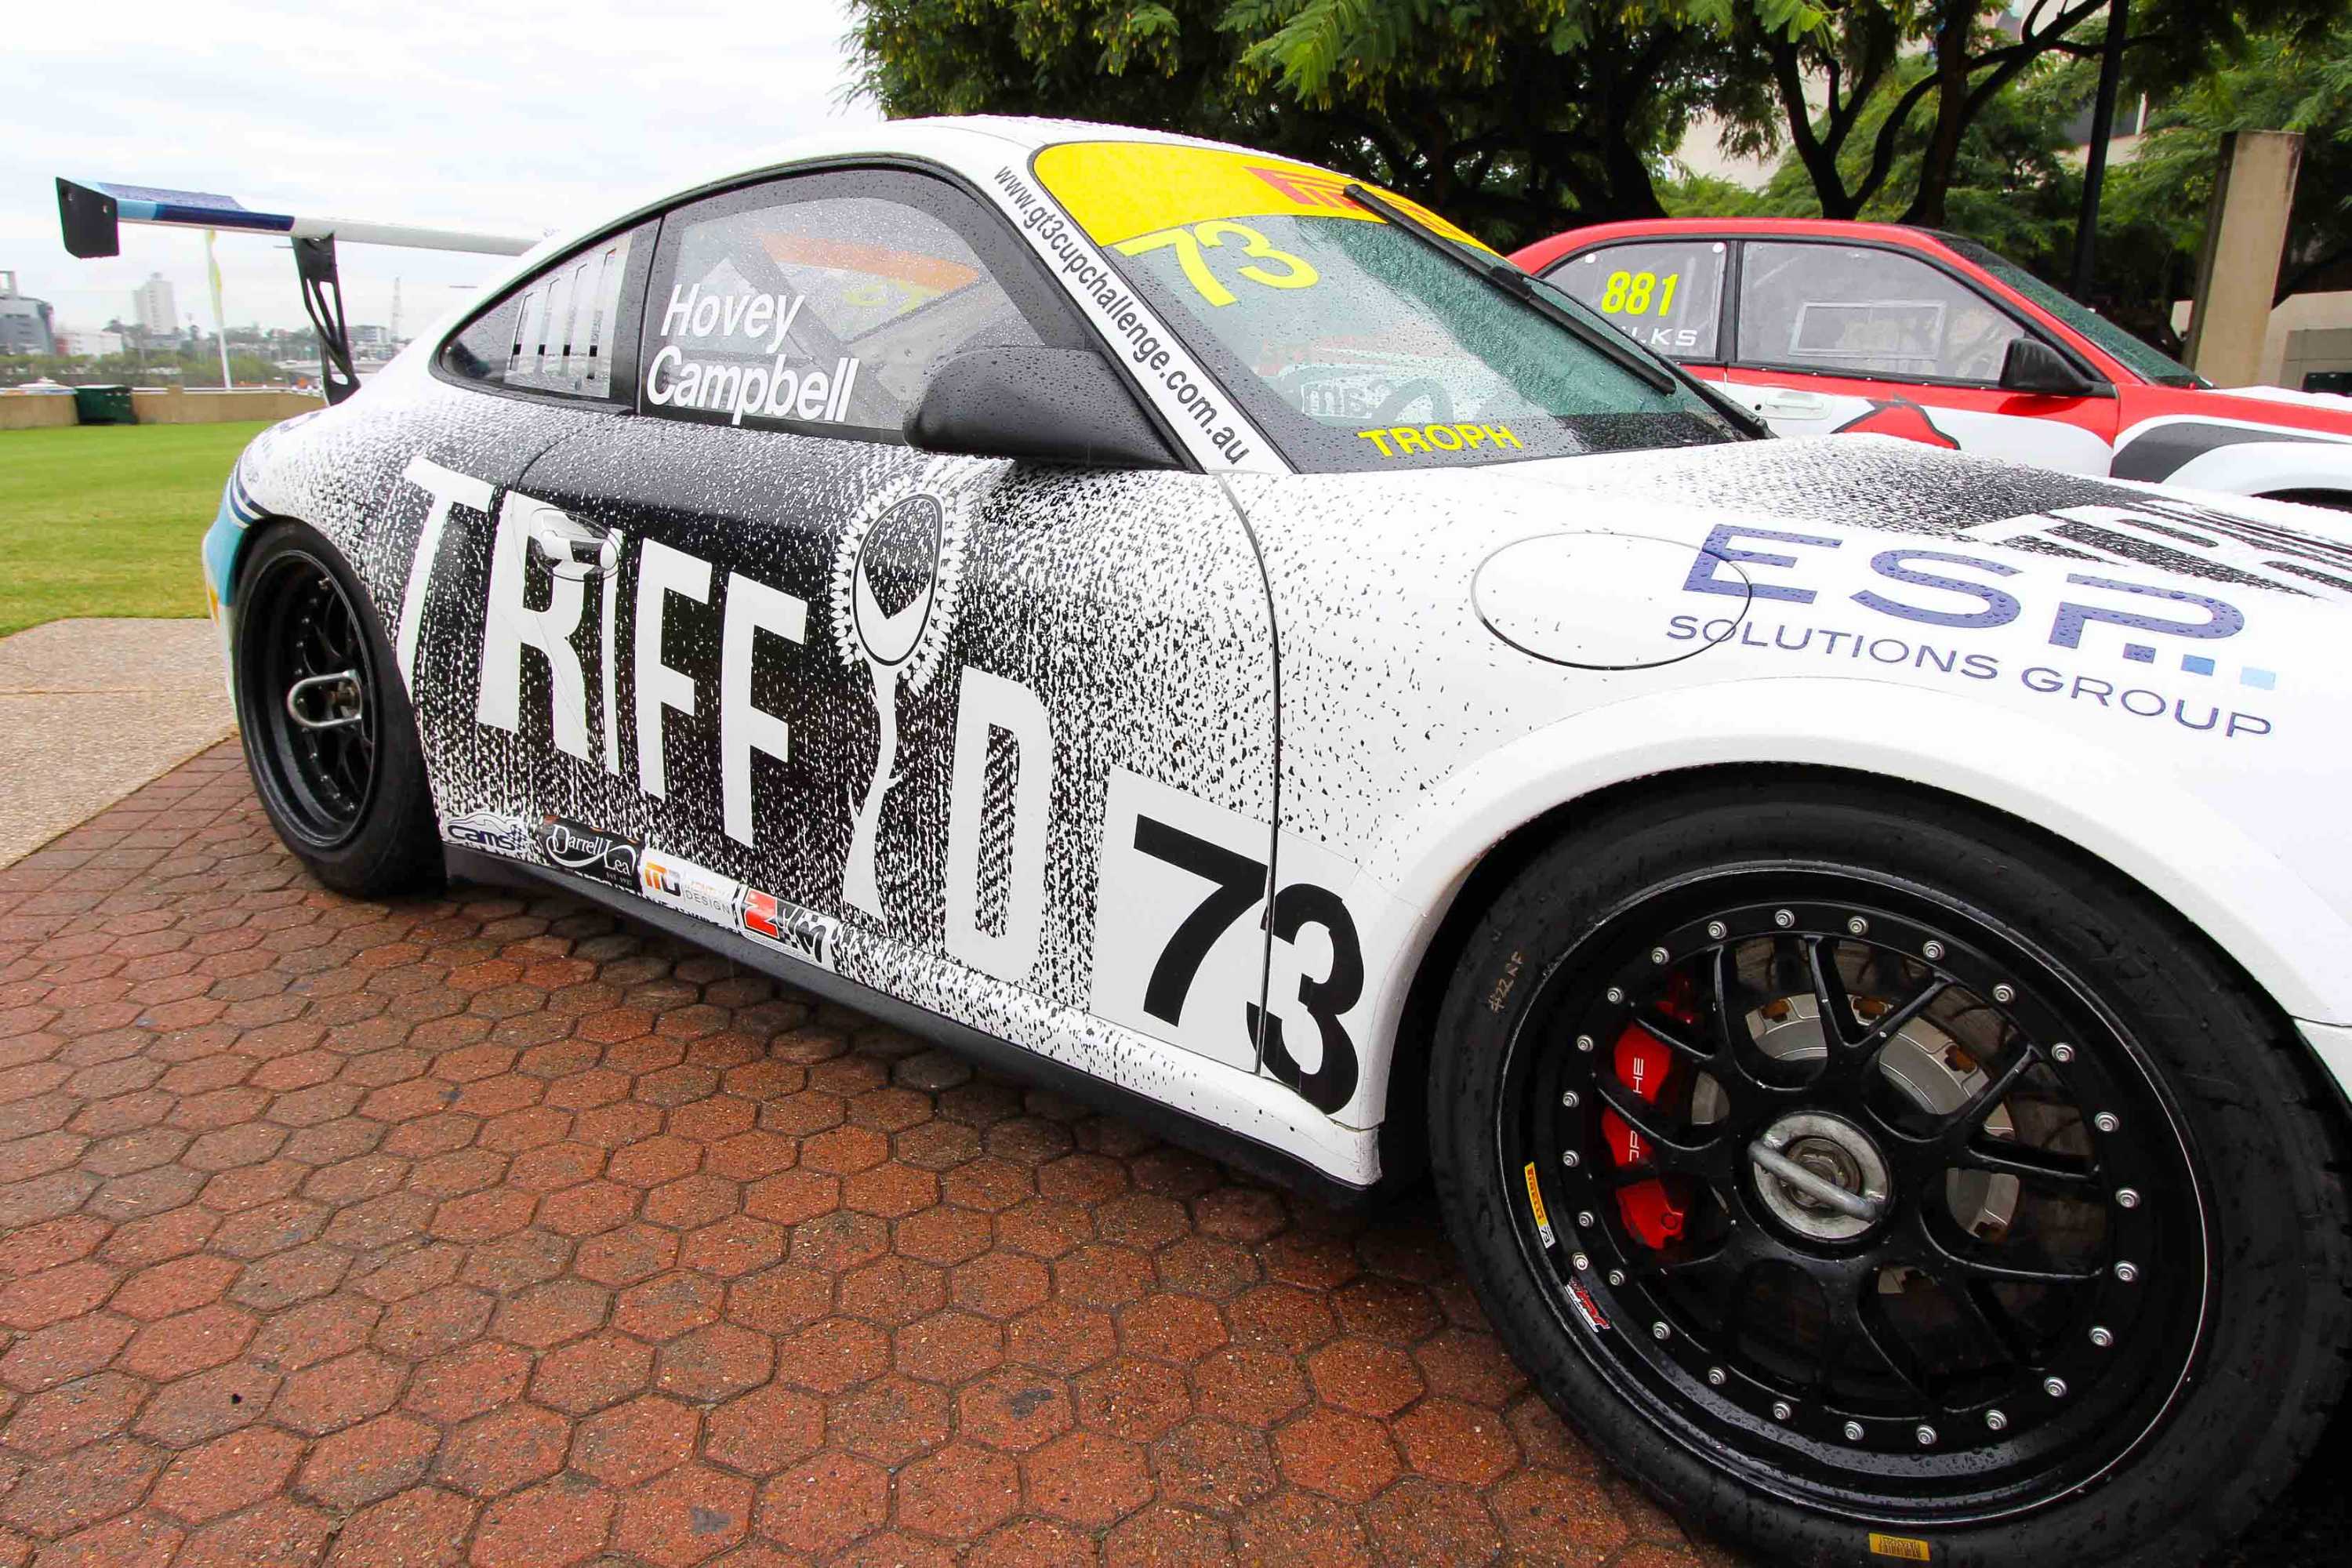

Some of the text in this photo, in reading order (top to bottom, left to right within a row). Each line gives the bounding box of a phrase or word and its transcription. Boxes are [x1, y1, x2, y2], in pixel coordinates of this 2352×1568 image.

[1115, 220, 1319, 307] 73
[1602, 271, 1679, 317] 881
[660, 283, 807, 352] Hovey
[994, 166, 1250, 464] www.gt3cupchallenge.com.au
[648, 345, 860, 425] Campbell
[1357, 424, 1523, 457] TROPH
[1667, 615, 2272, 738] SOLUTIONS GROUP
[546, 824, 633, 877] Darrell Lea
[685, 889, 730, 915] DESIGN
[1134, 814, 1365, 1115] 73
